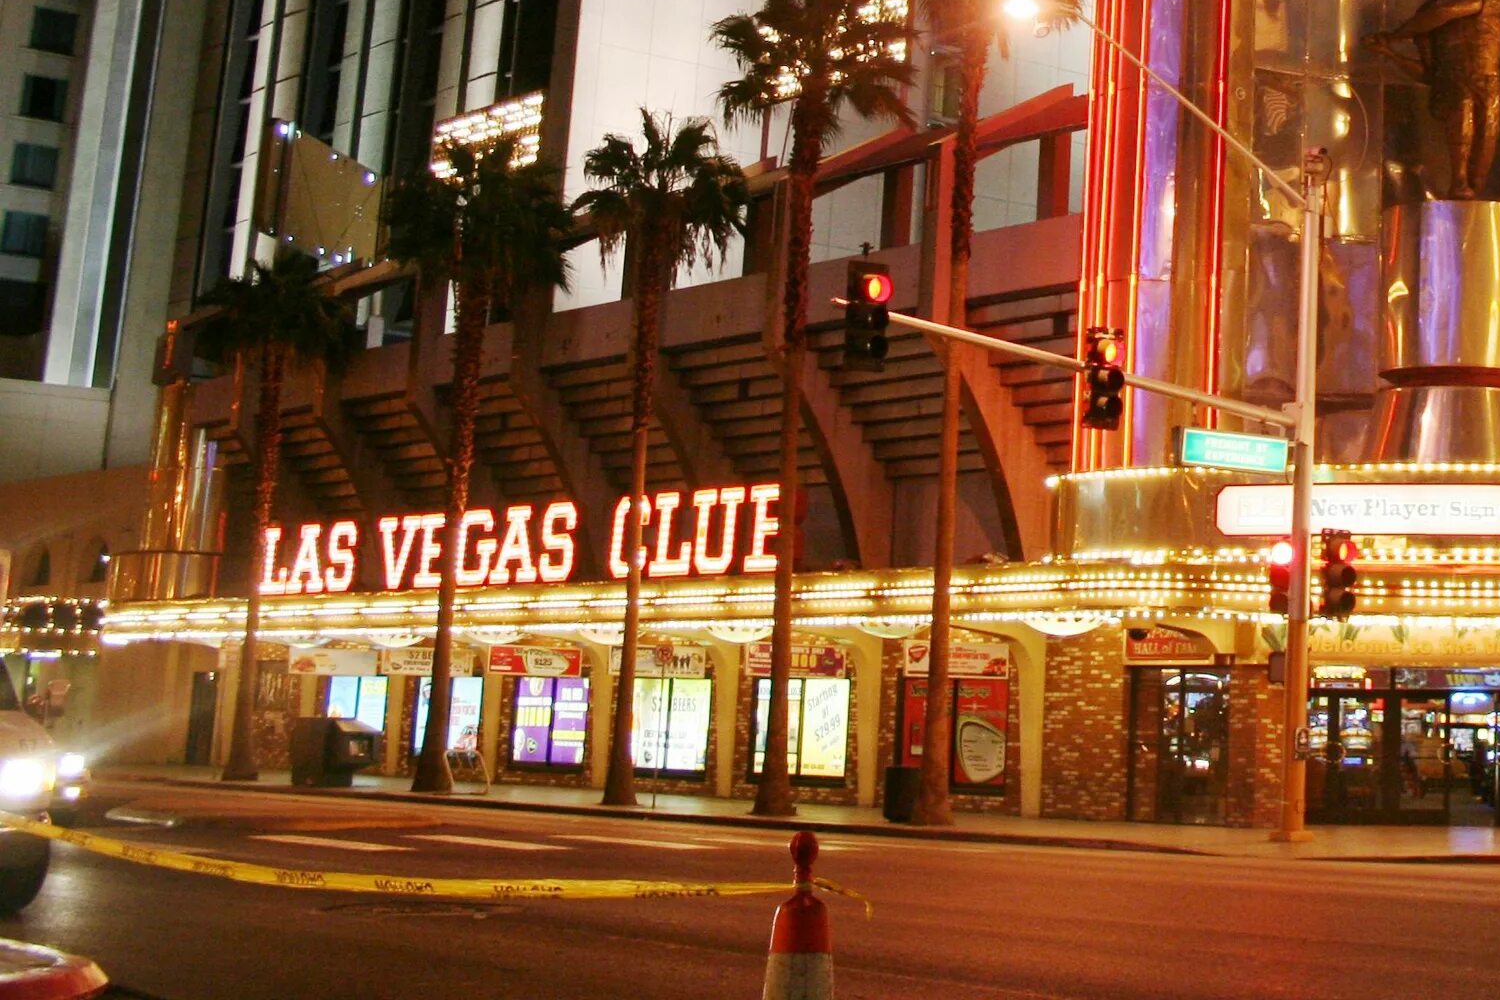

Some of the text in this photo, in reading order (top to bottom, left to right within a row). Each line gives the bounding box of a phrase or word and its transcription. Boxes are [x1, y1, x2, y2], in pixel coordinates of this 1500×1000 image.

[1311, 499, 1357, 517] New
[1363, 499, 1439, 520] Player
[258, 520, 357, 594] LAS
[379, 501, 577, 591] VEGAS
[1410, 638, 1432, 658] to
[1442, 637, 1476, 657] the
[672, 697, 697, 713] BEERS
[807, 683, 839, 712] Starting
